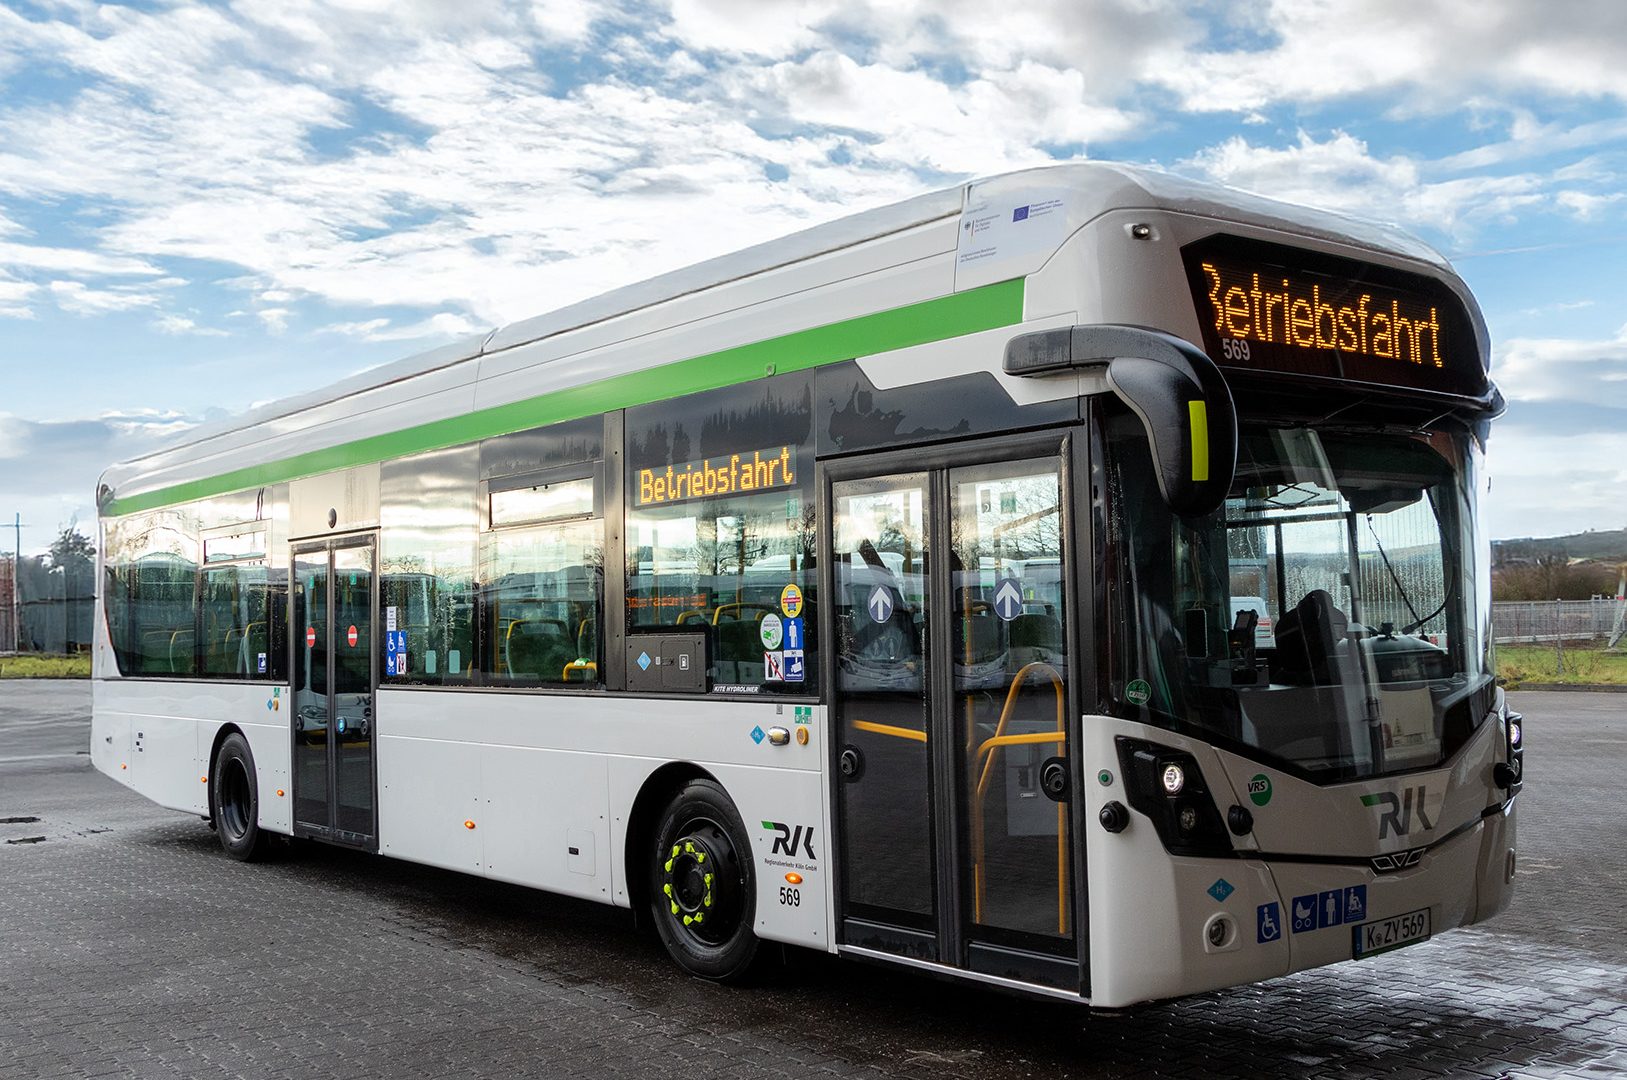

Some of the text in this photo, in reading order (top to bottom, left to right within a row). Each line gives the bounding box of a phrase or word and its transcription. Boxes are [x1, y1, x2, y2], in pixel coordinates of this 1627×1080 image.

[1222, 338, 1250, 361] 569
[639, 447, 793, 504] Betriebsfahrt
[1247, 780, 1266, 792] VRS
[779, 886, 800, 907] 569
[1367, 914, 1424, 948] K ZY 569
